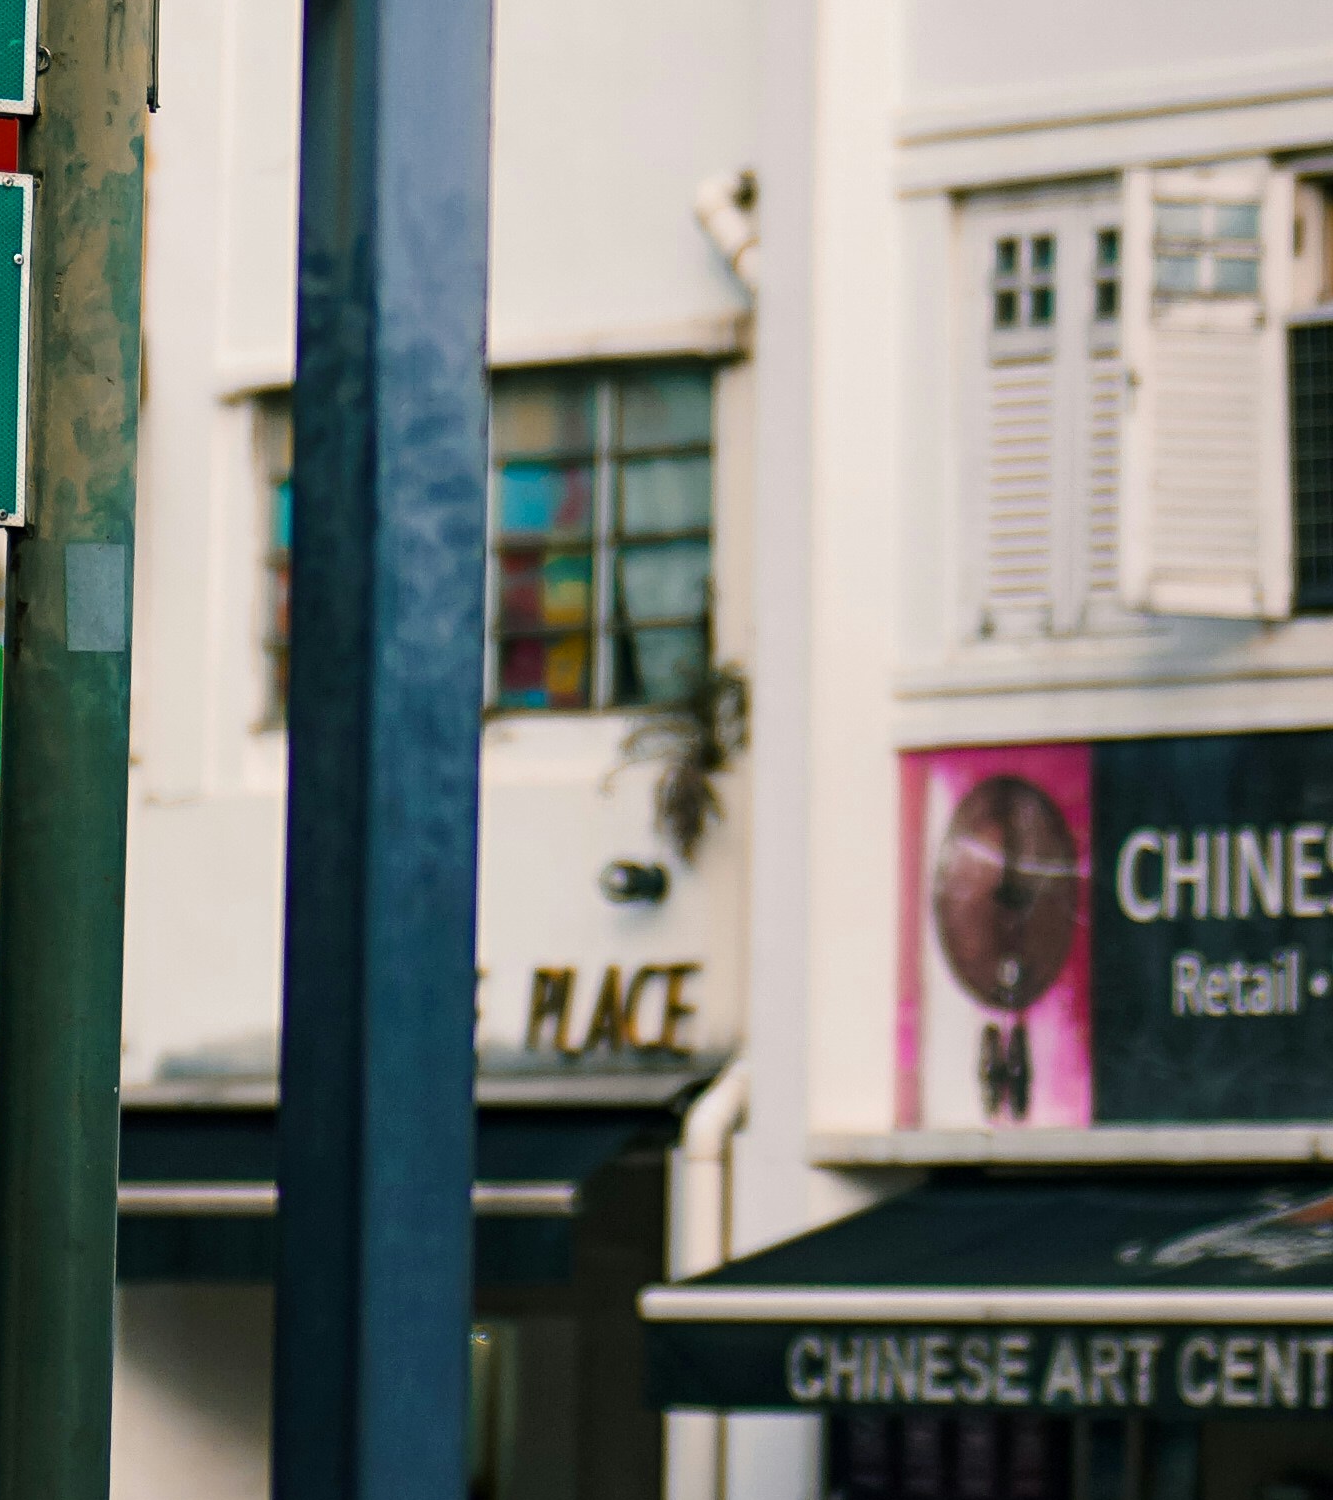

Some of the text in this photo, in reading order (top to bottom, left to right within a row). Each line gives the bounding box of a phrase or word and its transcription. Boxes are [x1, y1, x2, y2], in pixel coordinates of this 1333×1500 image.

[1115, 823, 1333, 924] CHINE
[524, 960, 704, 1060] PLACE
[1170, 948, 1302, 1017] Retail
[786, 1331, 1031, 1404] CHINESE
[1039, 1333, 1162, 1406] ART
